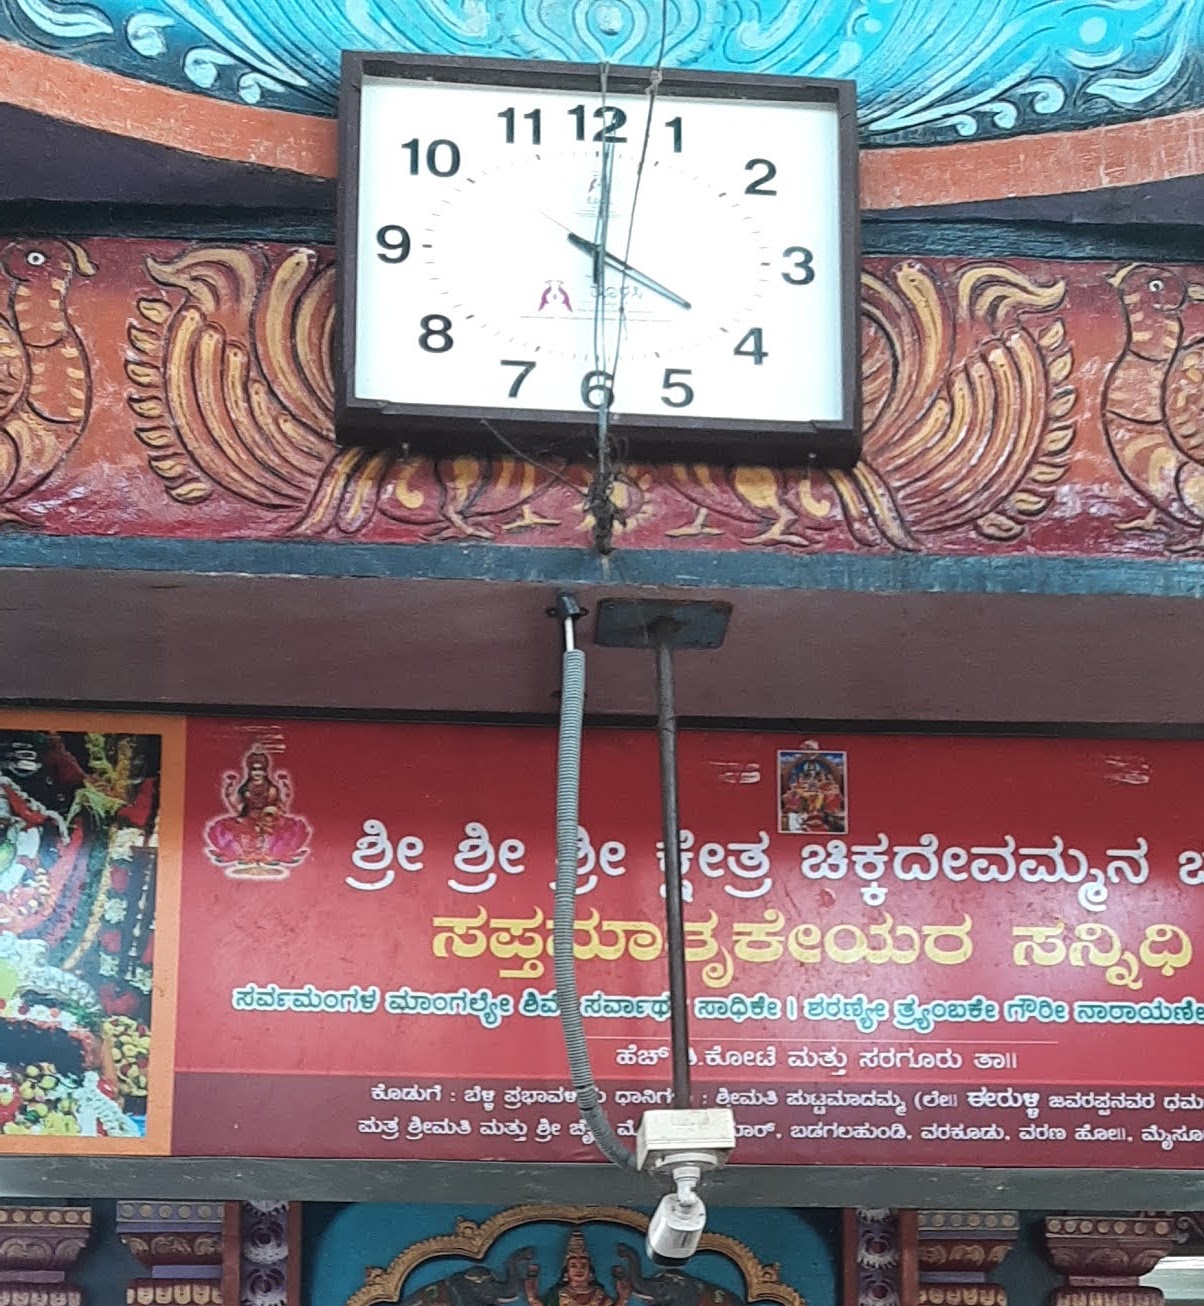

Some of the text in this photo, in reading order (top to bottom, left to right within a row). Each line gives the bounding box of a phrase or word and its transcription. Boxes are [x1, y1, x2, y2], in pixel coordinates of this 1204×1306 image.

[497, 106, 542, 145] 11
[567, 104, 628, 144] 12
[664, 116, 683, 153] 1
[401, 138, 461, 177] 10
[744, 158, 778, 197] 2
[375, 224, 411, 264] 9
[781, 246, 816, 286] 3
[418, 314, 454, 354] 8
[733, 327, 769, 366] 4
[500, 359, 537, 399] 7
[580, 370, 616, 410] 6
[660, 368, 695, 409] 5
[345, 819, 425, 890] ಶ್ರೀ
[448, 822, 526, 893] ಶ್ರೀ
[800, 832, 1149, 912] ಚಿಕ್ಕದೇವಮ್ಮನ
[1012, 917, 1193, 990] ಸನ್ನಿಧಿ
[787, 1046, 848, 1076] ಮತ್ತು
[858, 1047, 963, 1069] ಸರಗೂರು
[370, 1083, 442, 1101] ಕೊಡುಗೆ
[715, 1087, 778, 1107] ಶ್ರೀಮತಿ
[405, 1115, 472, 1140] ಶ್ರೀಮತಿ
[479, 1118, 528, 1142] ಮತ್ತು
[534, 1118, 562, 1142] ಶ್ರೀ
